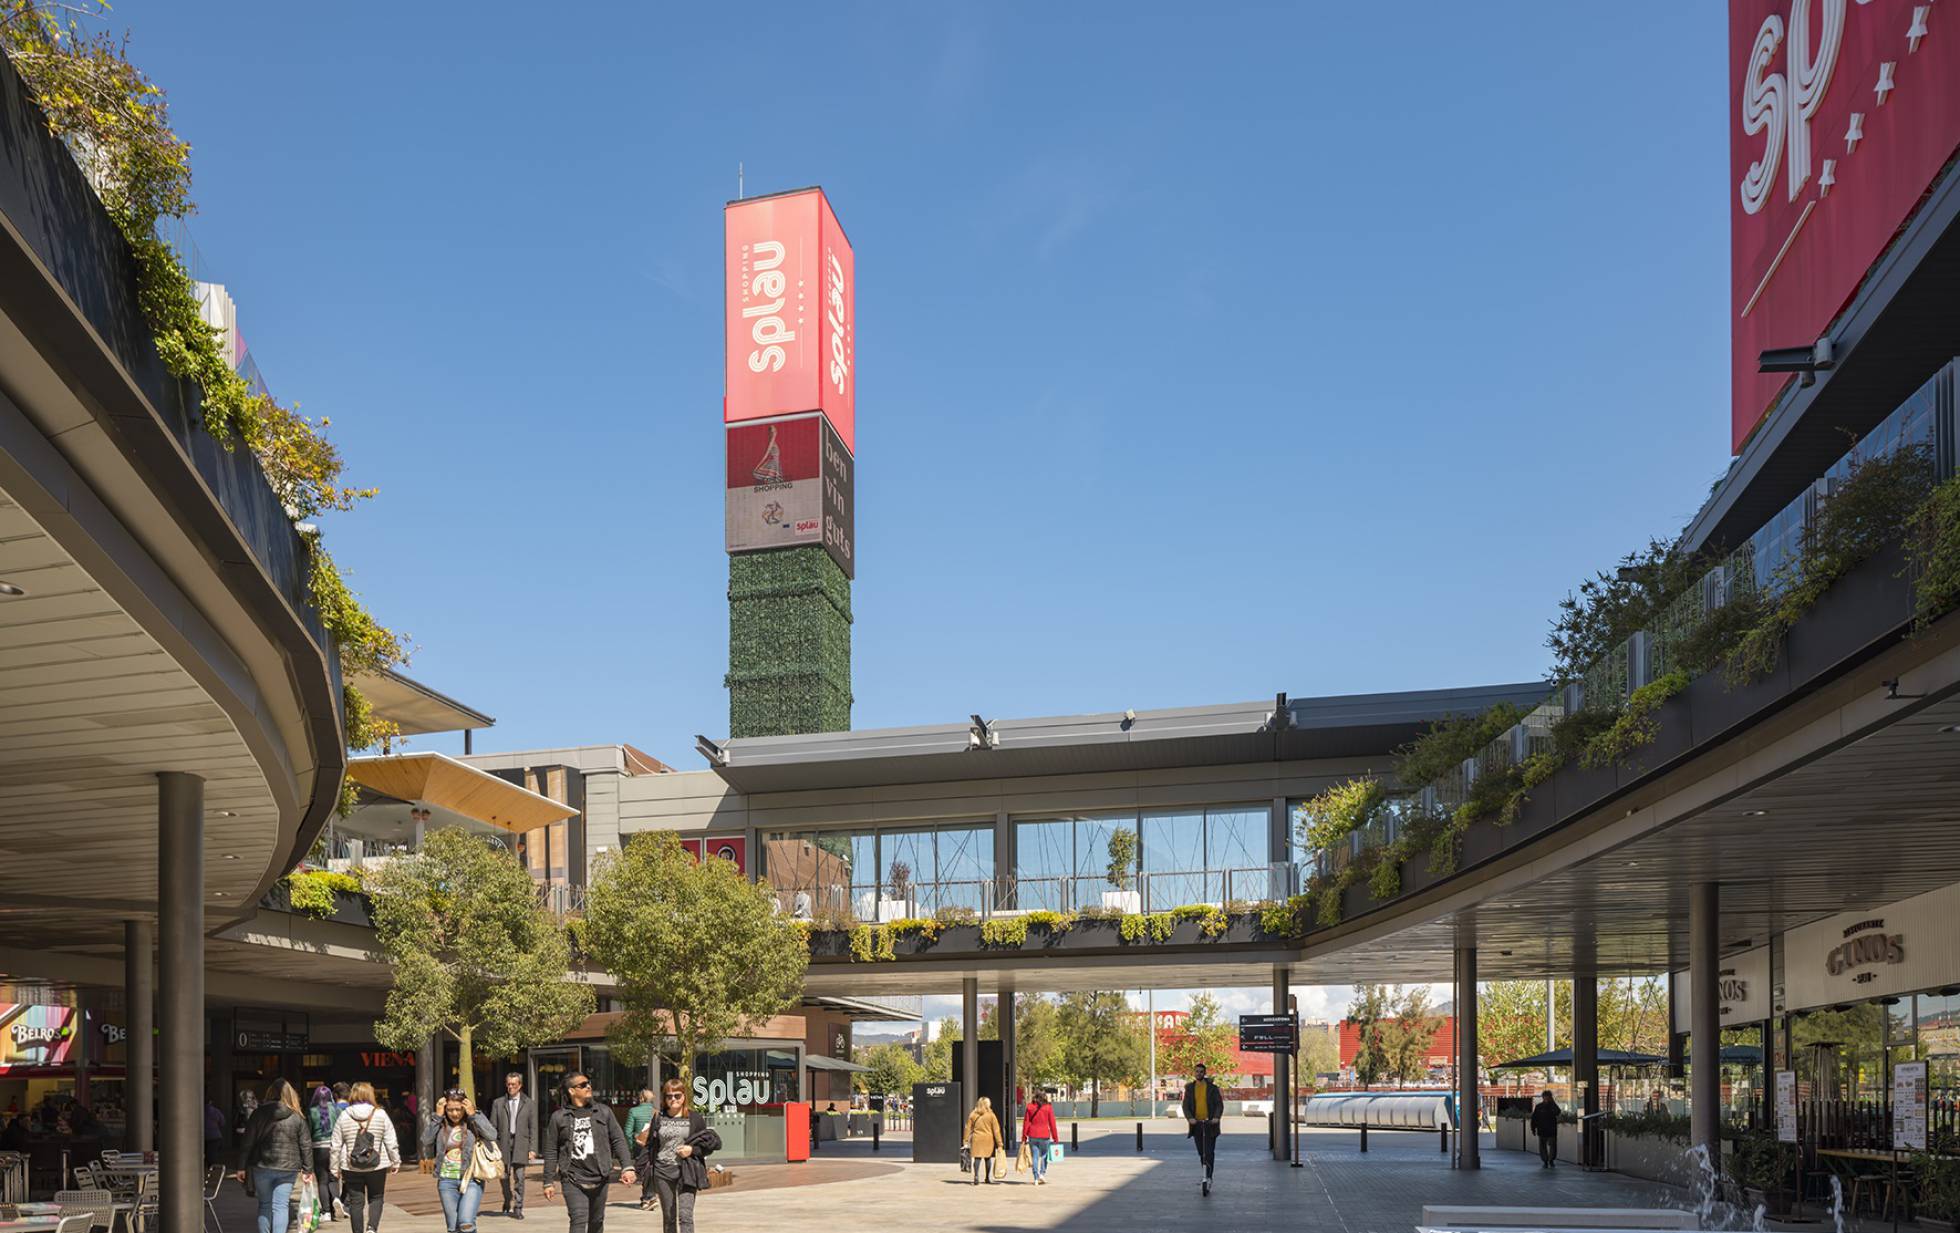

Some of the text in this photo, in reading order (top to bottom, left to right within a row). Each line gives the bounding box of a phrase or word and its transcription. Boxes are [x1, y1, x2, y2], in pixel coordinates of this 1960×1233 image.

[742, 240, 796, 373] splau
[828, 253, 848, 395] splau
[825, 425, 847, 482] ben
[753, 482, 793, 493] SHOPPING
[825, 475, 845, 516] vin
[796, 520, 818, 532] splau
[825, 516, 851, 559] guts
[1825, 933, 1905, 977] GINOS
[11, 1023, 62, 1045] BELROS
[692, 1071, 770, 1113] splau
